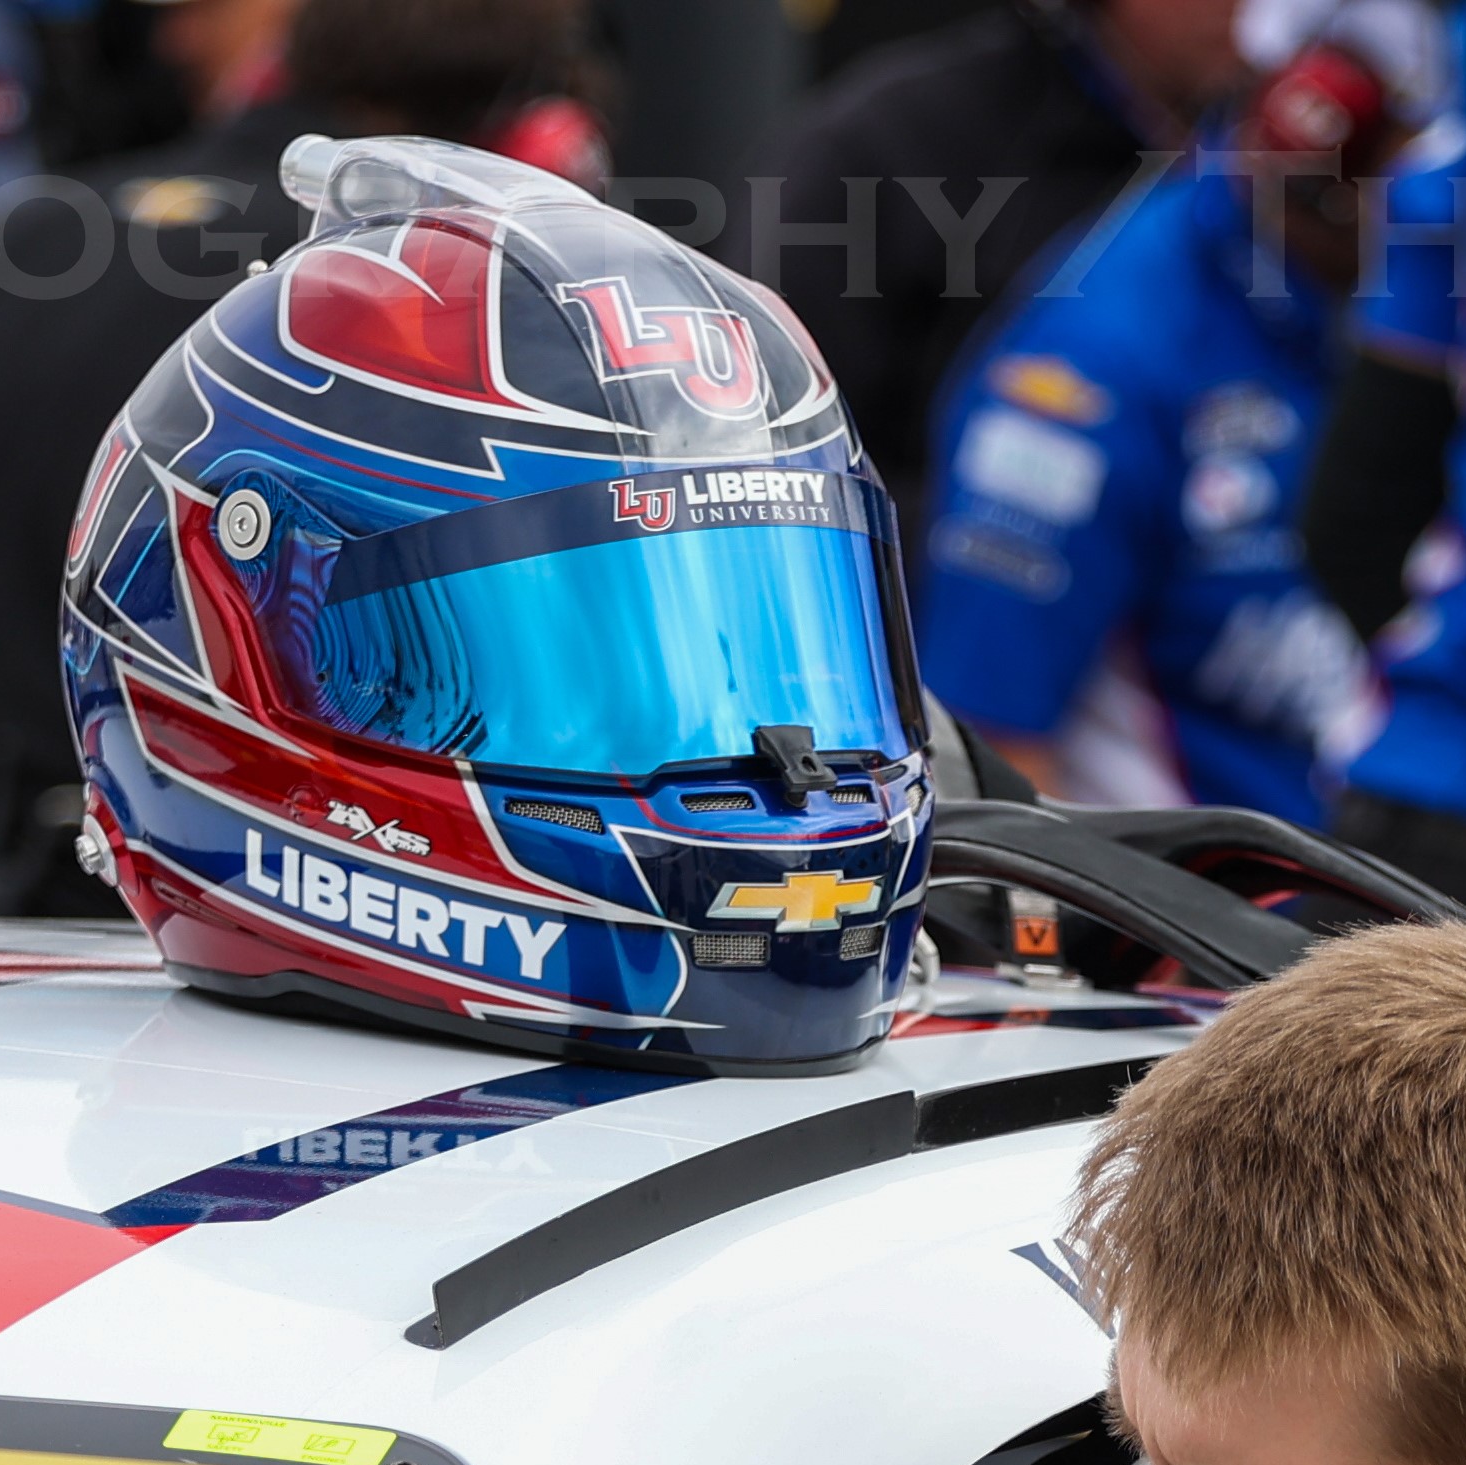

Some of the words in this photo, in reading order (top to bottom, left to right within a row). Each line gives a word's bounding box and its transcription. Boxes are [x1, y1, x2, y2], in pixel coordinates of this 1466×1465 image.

[682, 471, 825, 505] LIBERTY
[688, 505, 831, 525] UNIVERSITY
[245, 828, 567, 980] LIBERTY
